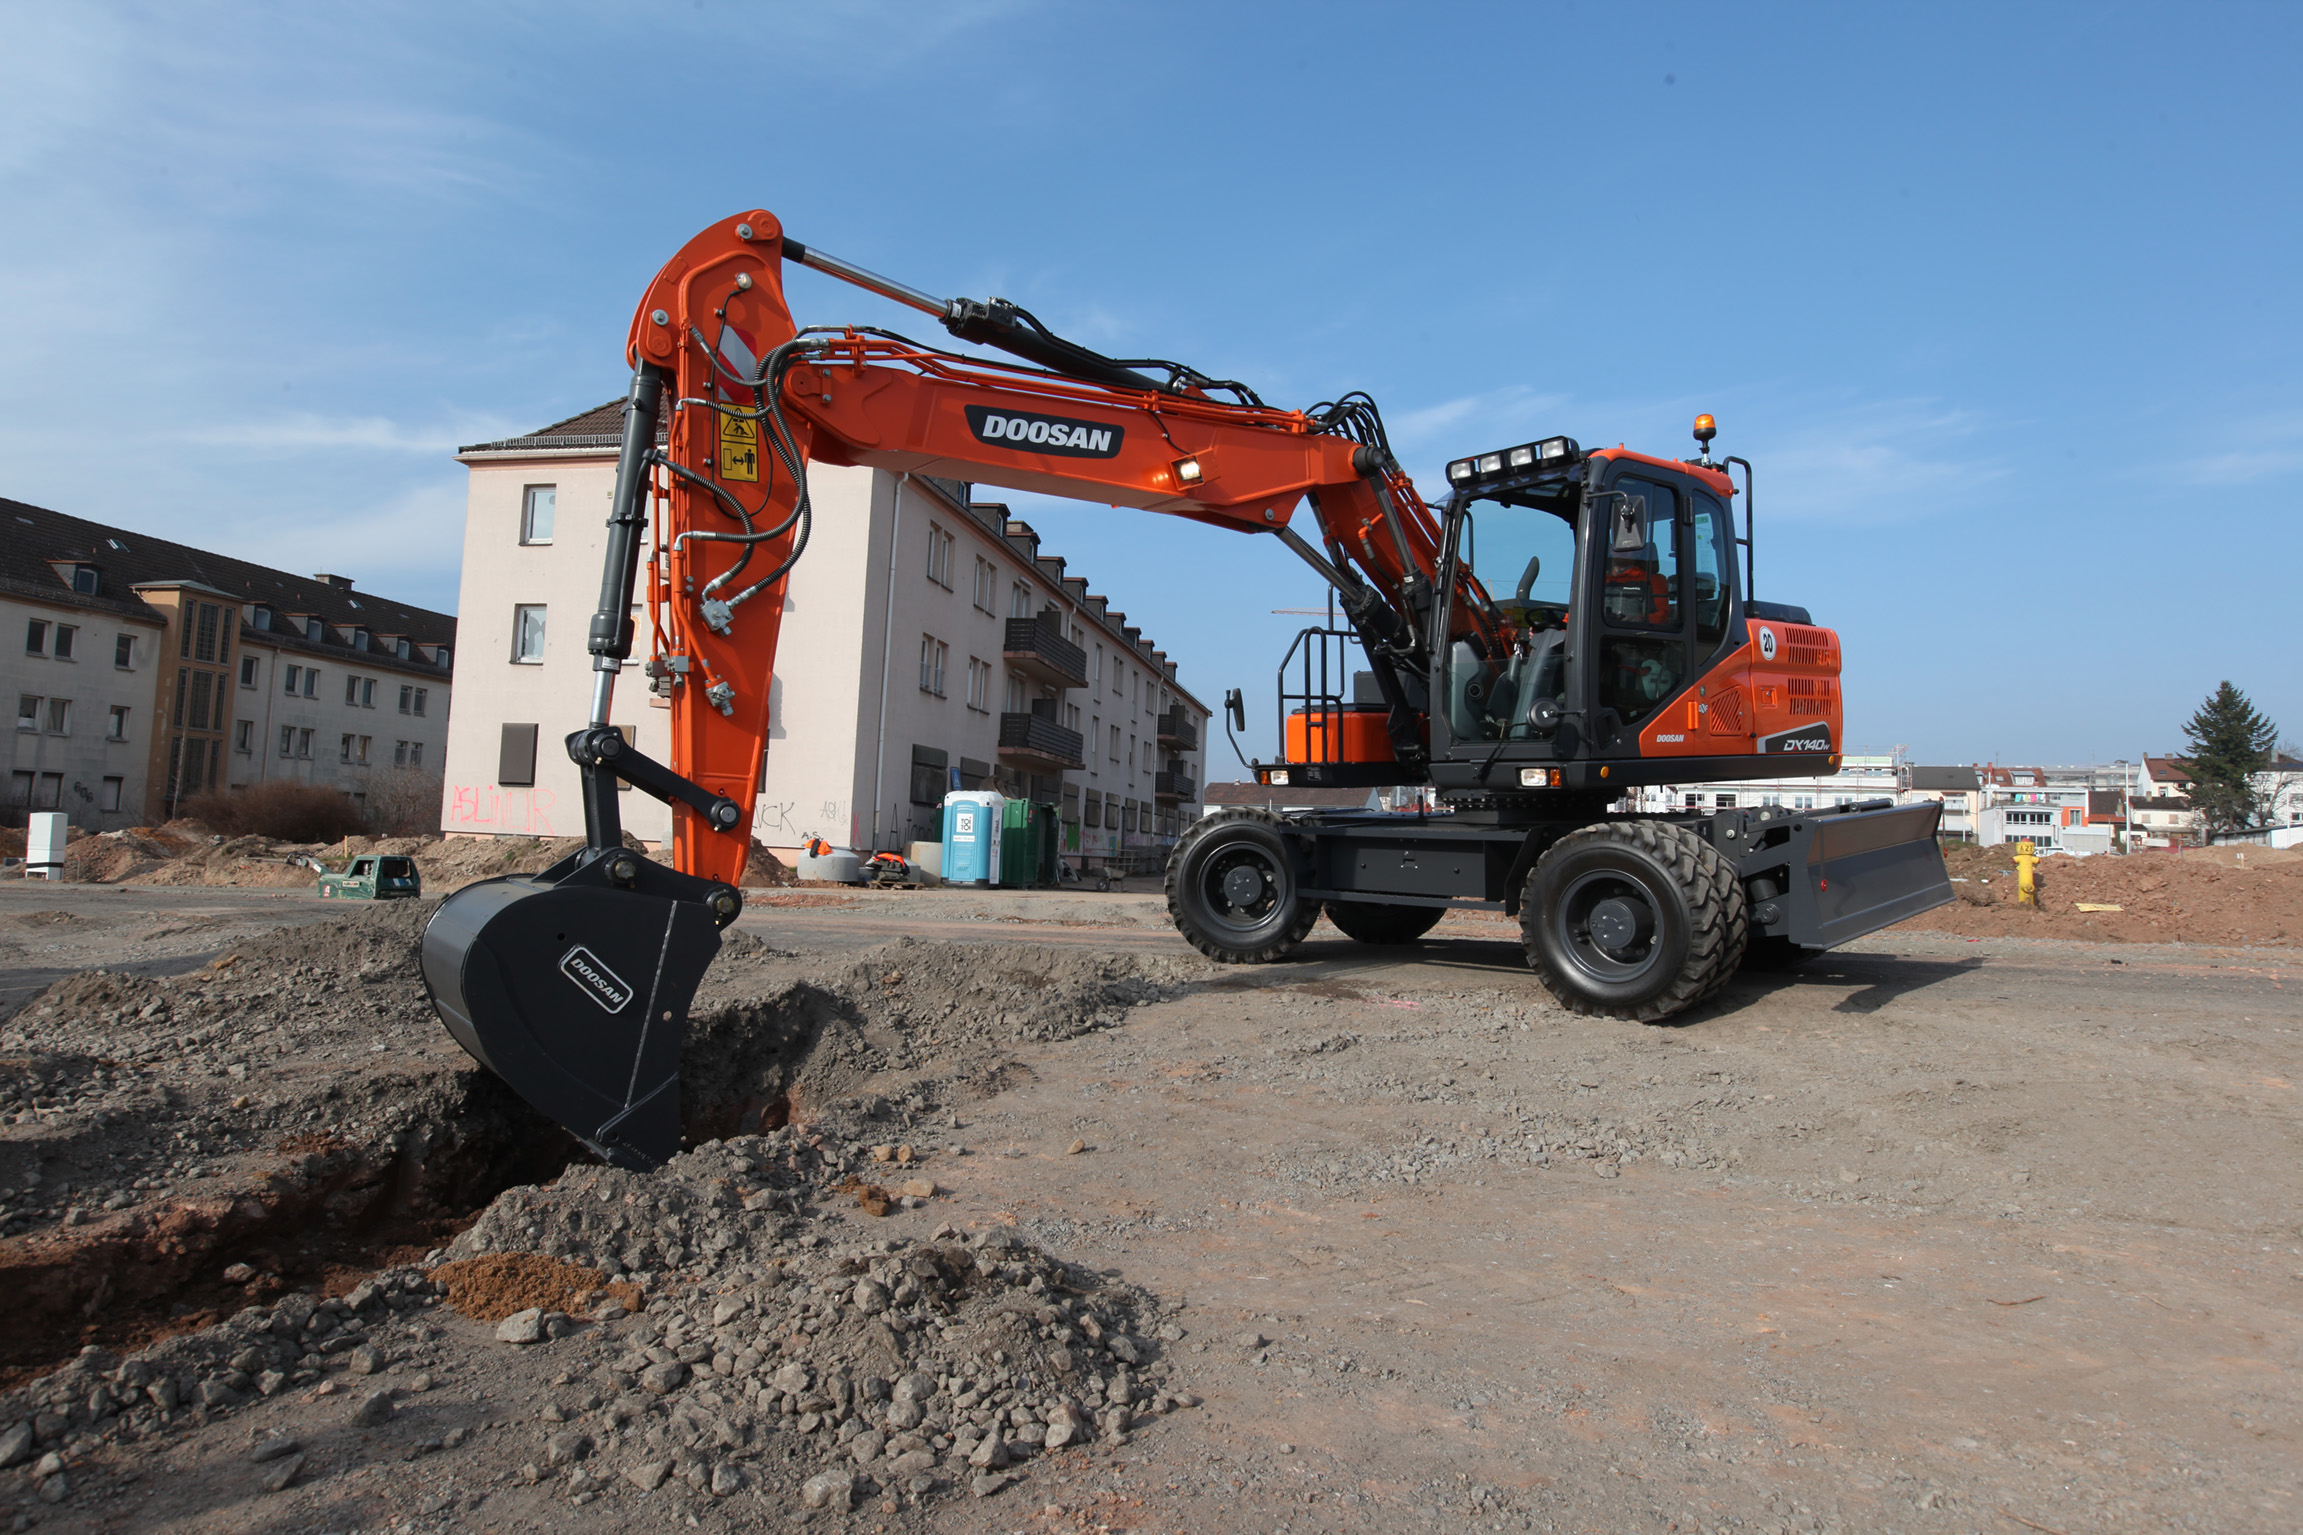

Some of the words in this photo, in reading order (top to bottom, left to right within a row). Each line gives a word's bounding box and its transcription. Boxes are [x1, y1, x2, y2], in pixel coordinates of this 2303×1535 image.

[983, 415, 1112, 452] DOOSAN
[1763, 633, 1773, 653] 20
[1656, 734, 1685, 743] DOOSAN
[569, 958, 624, 1004] DOOSAN
